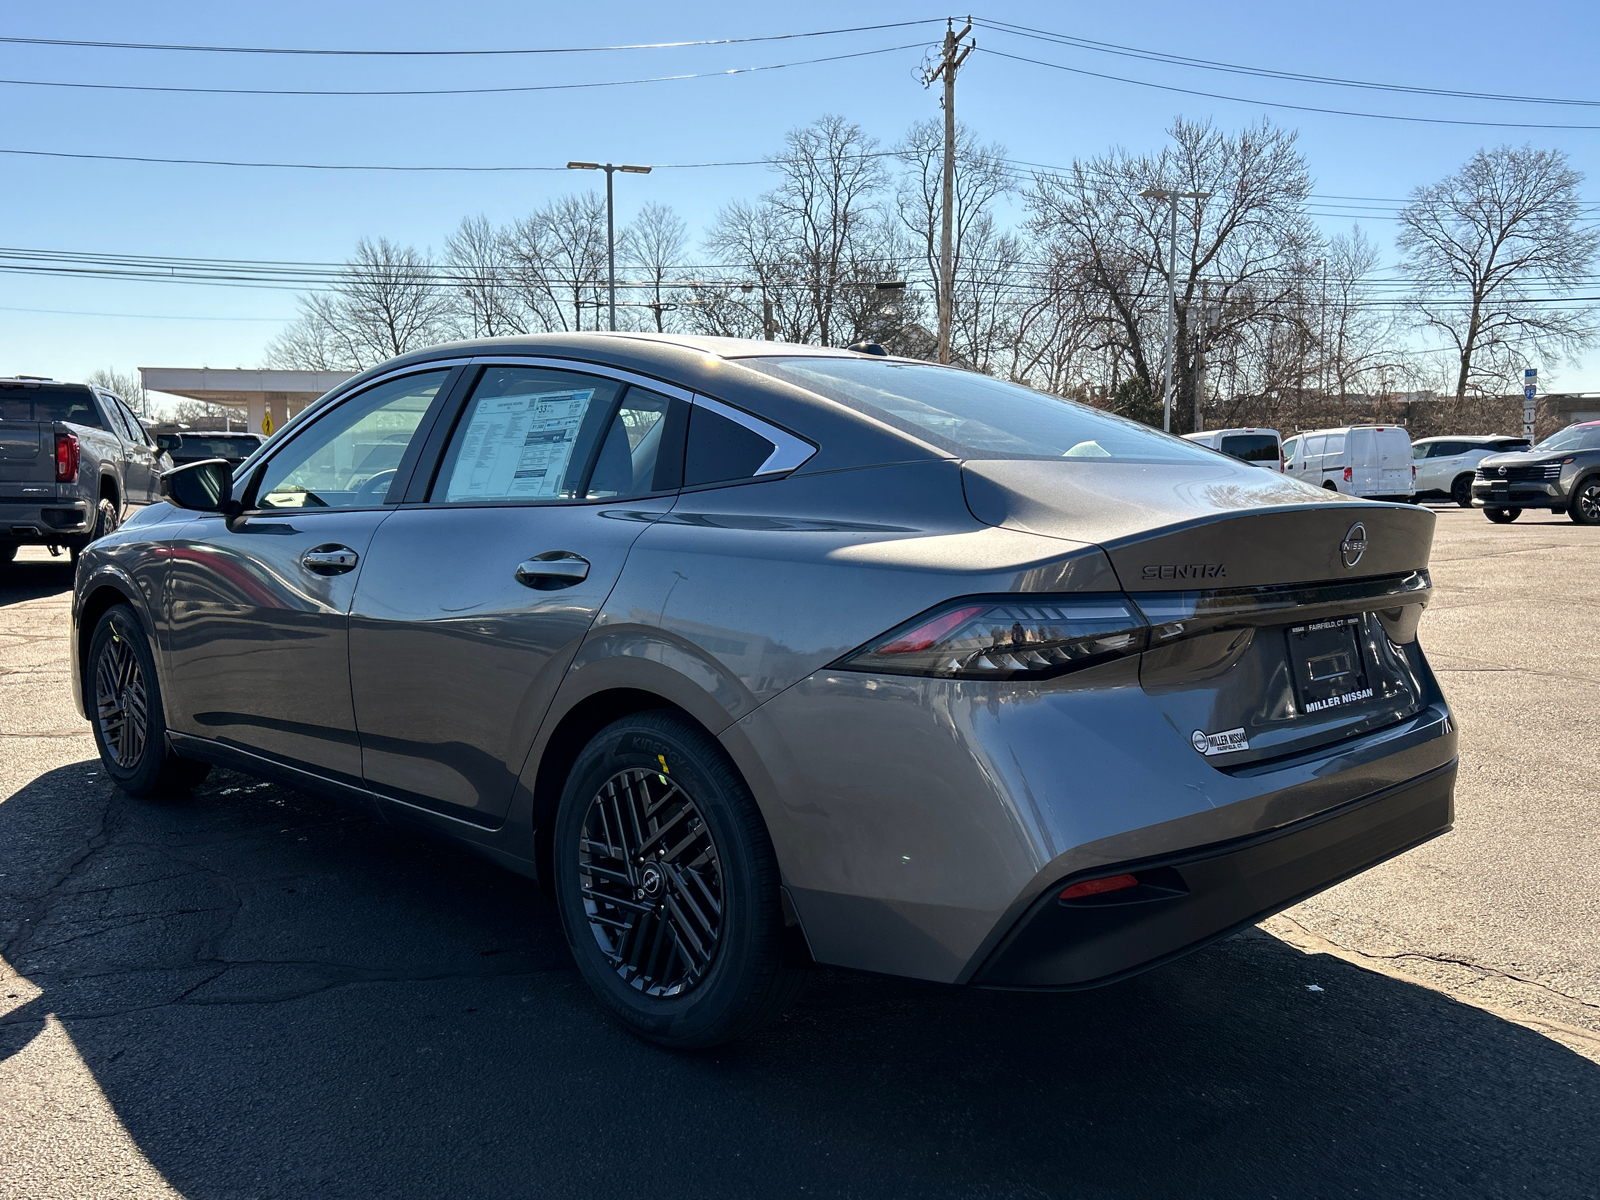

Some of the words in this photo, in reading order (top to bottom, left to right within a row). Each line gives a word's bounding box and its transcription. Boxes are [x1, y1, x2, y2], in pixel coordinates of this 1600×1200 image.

[1525, 389, 1535, 398] 95
[1343, 541, 1367, 551] NISSA
[1142, 563, 1227, 580] SENTRA
[1305, 696, 1341, 713] MILLER
[1342, 688, 1373, 704] NISSAN
[1208, 734, 1229, 747] MILLER
[1228, 733, 1247, 744] NISSAN
